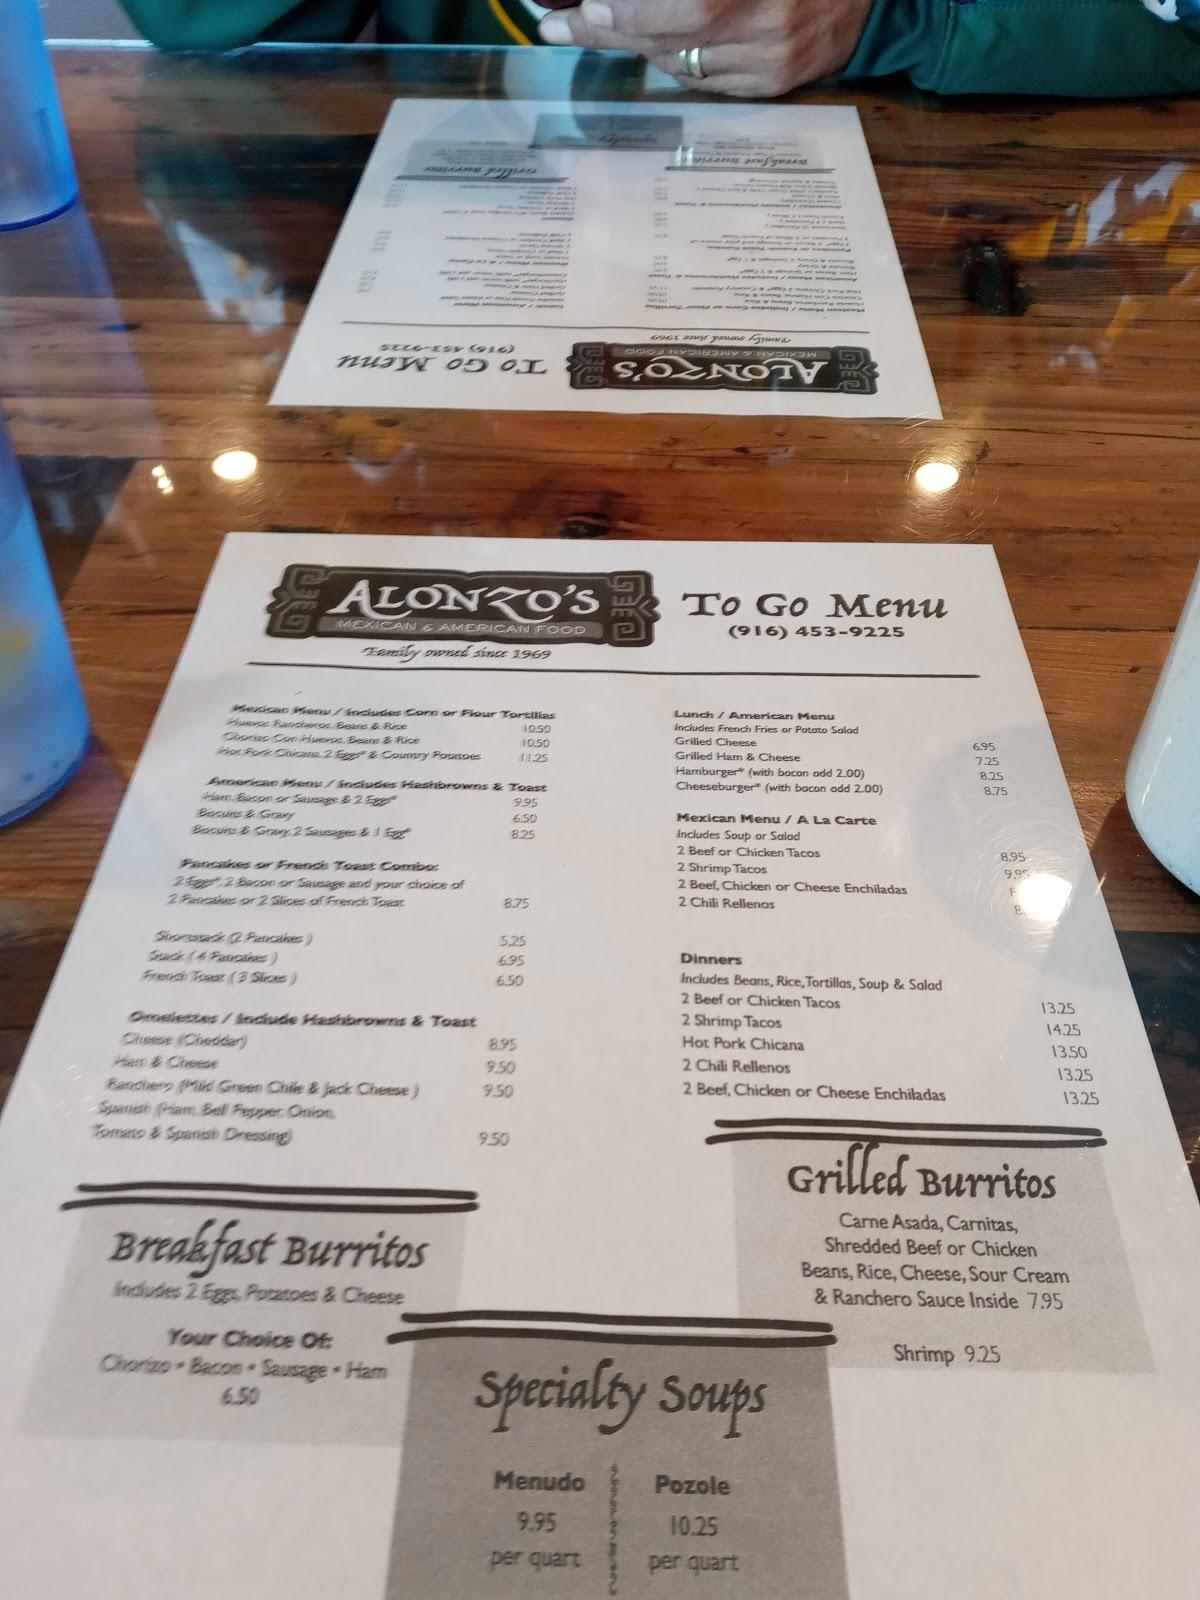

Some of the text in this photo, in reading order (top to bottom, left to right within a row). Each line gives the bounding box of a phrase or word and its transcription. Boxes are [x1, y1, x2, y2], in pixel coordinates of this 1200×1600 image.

[336, 355, 548, 375] To Go Menu
[611, 355, 829, 385] ALONZO'S
[325, 578, 600, 623] ALONZO'S
[682, 593, 948, 619] To Go Menu
[336, 619, 586, 635] MEXICAN AMERICAN FOOD
[729, 625, 905, 640] (916) 453-9225
[362, 644, 552, 663] Family owned since 1969
[674, 710, 714, 719] Lunch
[728, 711, 794, 720] American
[523, 725, 551, 734] 10.50
[674, 724, 859, 734] Includes French Fries Potato Salad
[674, 737, 757, 747] Grilled Cheese
[973, 743, 995, 752] 6.95
[520, 752, 548, 764] 11.25
[675, 751, 801, 762] Grilled Ham Cheese
[975, 757, 999, 766] 7.25
[748, 768, 865, 780] (with bacon add 2.00)
[980, 771, 1004, 782] 8.25
[984, 785, 1008, 796] 8.75
[514, 798, 537, 808] 9.95
[512, 814, 537, 824] 6.50
[677, 813, 877, 825] Mexican Menu La Carte
[510, 830, 535, 840] 8.25
[676, 829, 800, 843] Includes Soup Salad
[687, 845, 821, 858] Beef Chicken Tacos
[1000, 852, 1026, 862] 8.95
[688, 862, 767, 876] Shrimp Tacos
[504, 898, 529, 909] 8.75
[499, 935, 526, 947] 5.25
[498, 955, 525, 967] 6.95
[681, 952, 742, 965] Dinners
[681, 972, 942, 992] Includes Beans, Tortillas, Soup Salad
[1042, 1002, 1075, 1015] 13.25
[1047, 1023, 1081, 1036] 14.25
[488, 1038, 517, 1051] 8.95
[682, 1035, 805, 1051] Hot Pork Chicana
[1052, 1045, 1087, 1059] 13.50
[486, 1060, 516, 1075] 9.50
[695, 1058, 791, 1074] Chili Rellenos
[1058, 1068, 1093, 1082] 13.25
[697, 1082, 946, 1101] Beef, Chicken Cheese Enchiladas
[1064, 1091, 1099, 1105] 13.25
[478, 1131, 510, 1147] 9.50
[788, 1142, 1057, 1199] Grilled Burritos
[839, 1212, 1018, 1235] Carne Asada, Carnitas,
[109, 1218, 430, 1278] Breakfast Burritos
[825, 1236, 1038, 1258] Shredded Beef Chicken
[801, 1261, 1070, 1284] Beans, Rice, Cheese, Sour Cream
[243, 1283, 405, 1305] Potatoes Cheese
[832, 1288, 1063, 1310] Ranchero Sauce Inside 7.95
[168, 1328, 333, 1350] Your Choice Of:
[893, 1344, 1001, 1367] Shrimp 9.25
[188, 1356, 388, 1383] Bacon Sausage Ham
[220, 1386, 260, 1407] 6.50
[475, 1358, 768, 1438] Specialty Soups
[493, 1470, 586, 1492] Menudo
[655, 1474, 731, 1496] Pozole
[517, 1511, 557, 1533] 9.95
[670, 1515, 719, 1537] 10.25
[648, 1554, 739, 1576] per quart
